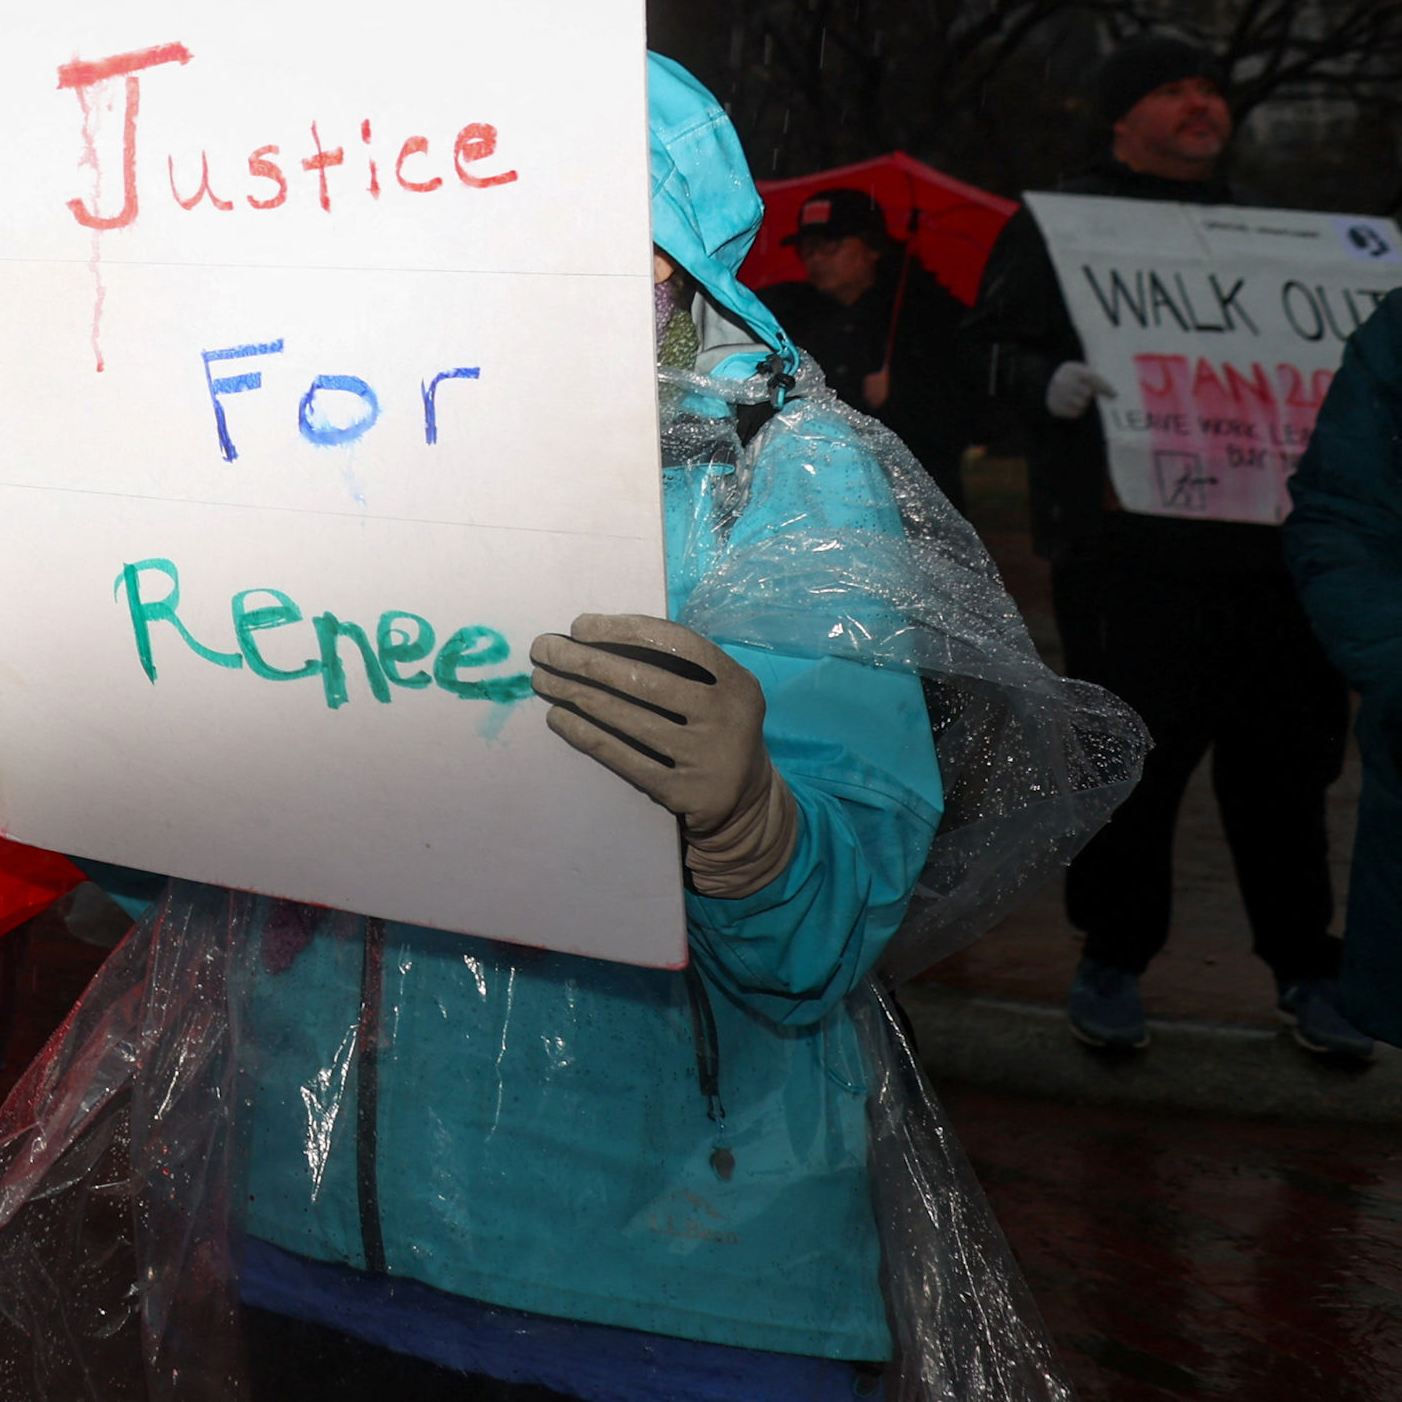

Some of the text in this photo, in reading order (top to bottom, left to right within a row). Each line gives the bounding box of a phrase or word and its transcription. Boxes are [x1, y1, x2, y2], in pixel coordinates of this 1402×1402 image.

[57, 43, 518, 230] Justice
[1081, 264, 1260, 337] WALK
[201, 339, 481, 463] For
[115, 556, 536, 711] Renee
